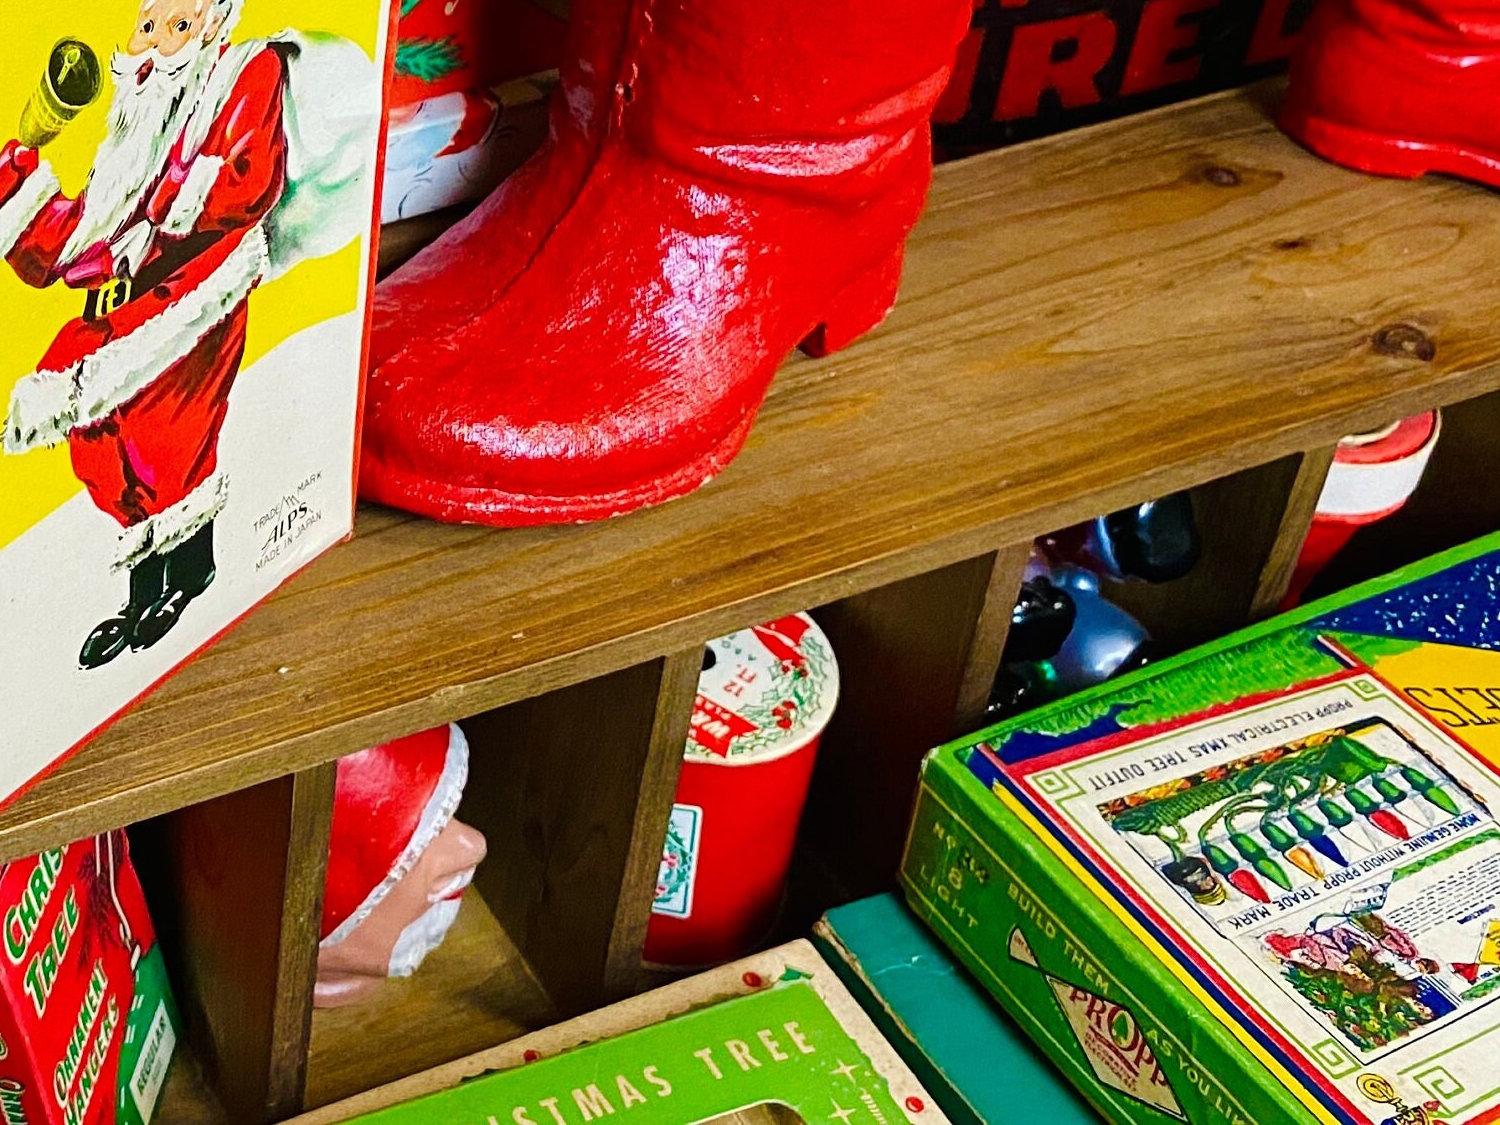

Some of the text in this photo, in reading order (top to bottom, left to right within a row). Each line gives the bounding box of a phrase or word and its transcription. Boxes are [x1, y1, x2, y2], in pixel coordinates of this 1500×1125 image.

[253, 469, 322, 532] TRADE MARK
[261, 501, 308, 551] ALPS
[255, 510, 322, 573] MADE IN JAPAN
[723, 679, 745, 698] 12
[1403, 686, 1500, 728] ETS
[1088, 698, 1354, 791] PROPP ELECTRICAL XMAS TREE OUTFIT
[1359, 842, 1410, 874] WITHOUT
[1410, 824, 1452, 853] GENUINE
[921, 862, 979, 928] LIGHT
[1277, 884, 1320, 911] TRADE
[1323, 867, 1362, 891] PROPP
[1227, 904, 1272, 931] MARK
[23, 884, 80, 1019] TREE
[1006, 881, 1056, 939] BUILD
[1062, 939, 1110, 995] THEM
[1146, 1029, 1173, 1057] AS
[1178, 1054, 1211, 1096] YOU
[54, 957, 109, 1110] ORNAMENT
[137, 1015, 167, 1097] REGULAR
[693, 1021, 816, 1080] TREE
[1069, 986, 1169, 1087] PROPP
